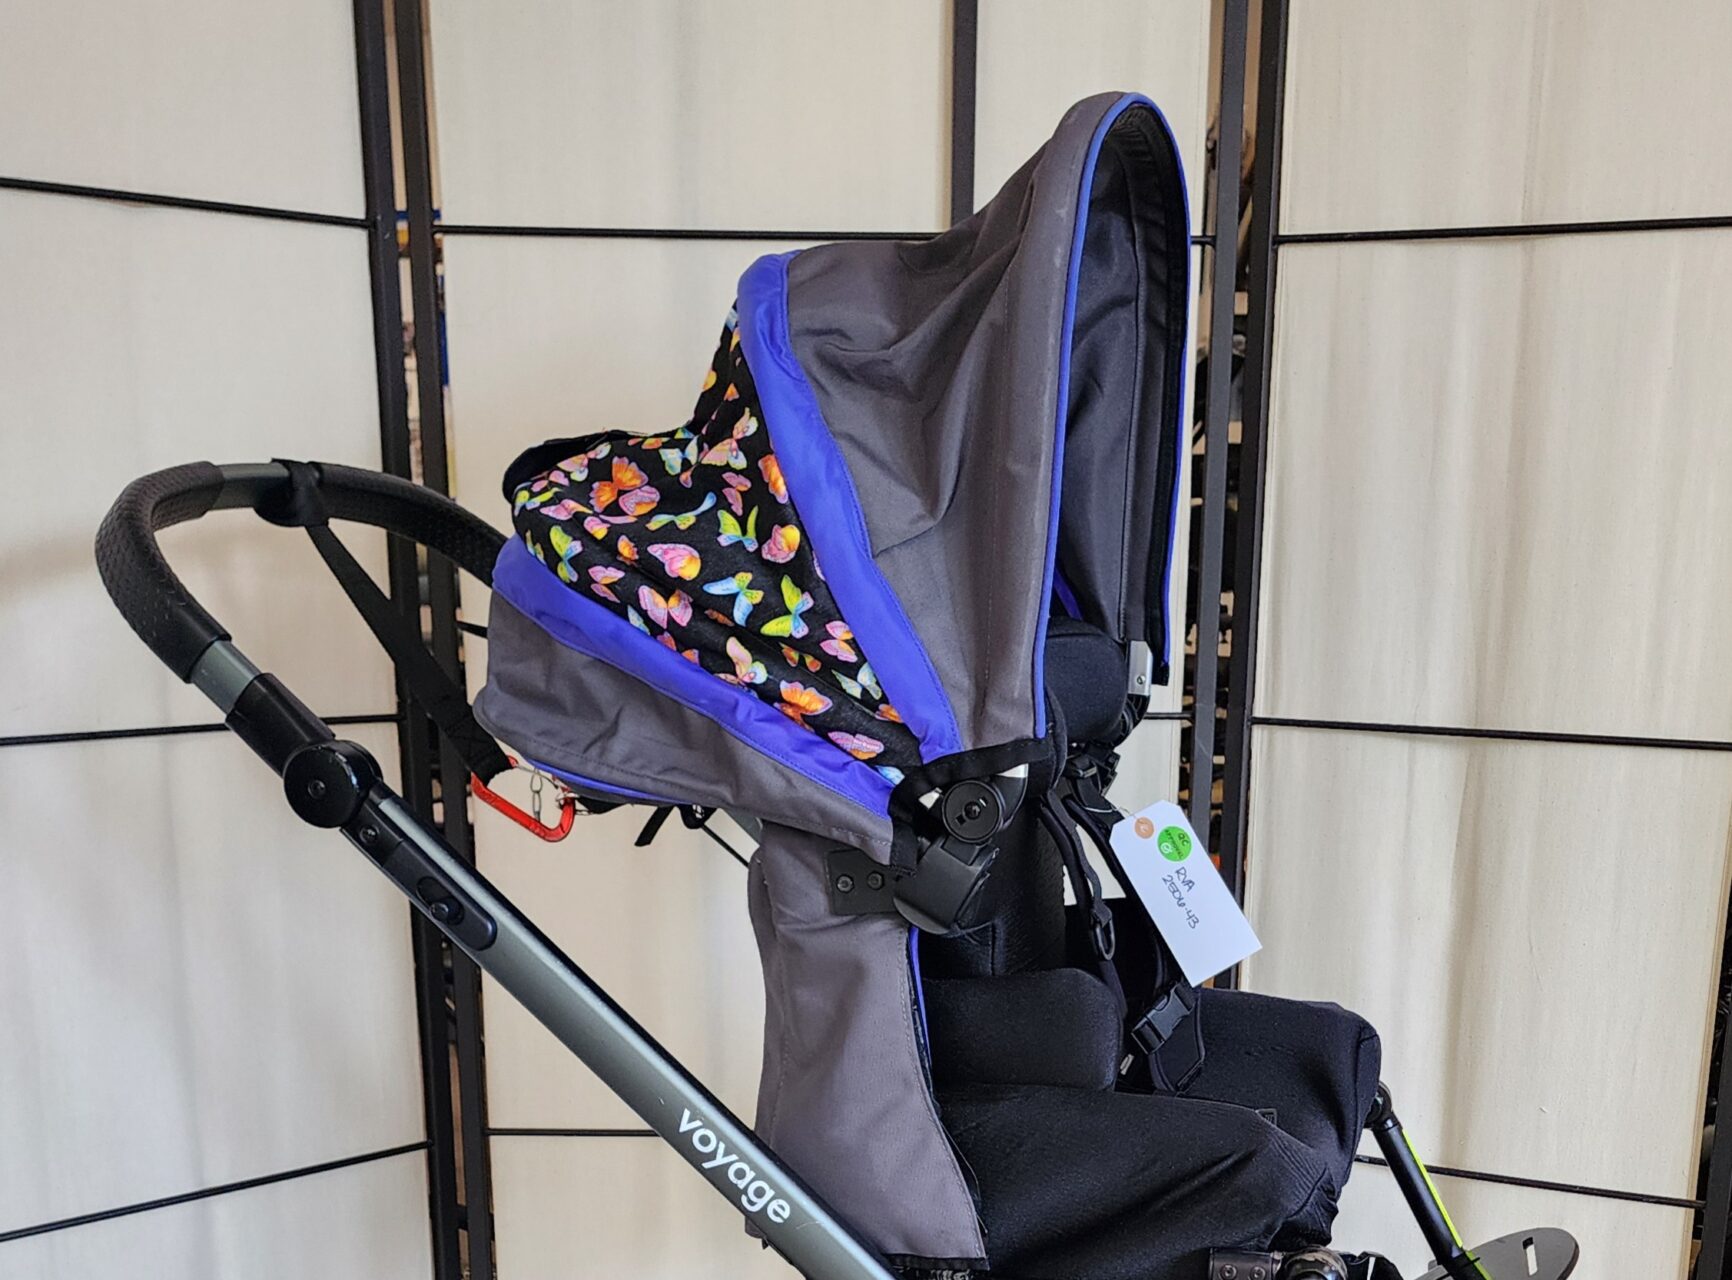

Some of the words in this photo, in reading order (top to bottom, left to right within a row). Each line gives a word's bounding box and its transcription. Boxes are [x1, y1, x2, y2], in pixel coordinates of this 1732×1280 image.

[1178, 833, 1190, 847] QC
[1174, 866, 1195, 893] RVA
[678, 1108, 791, 1224] voyage
